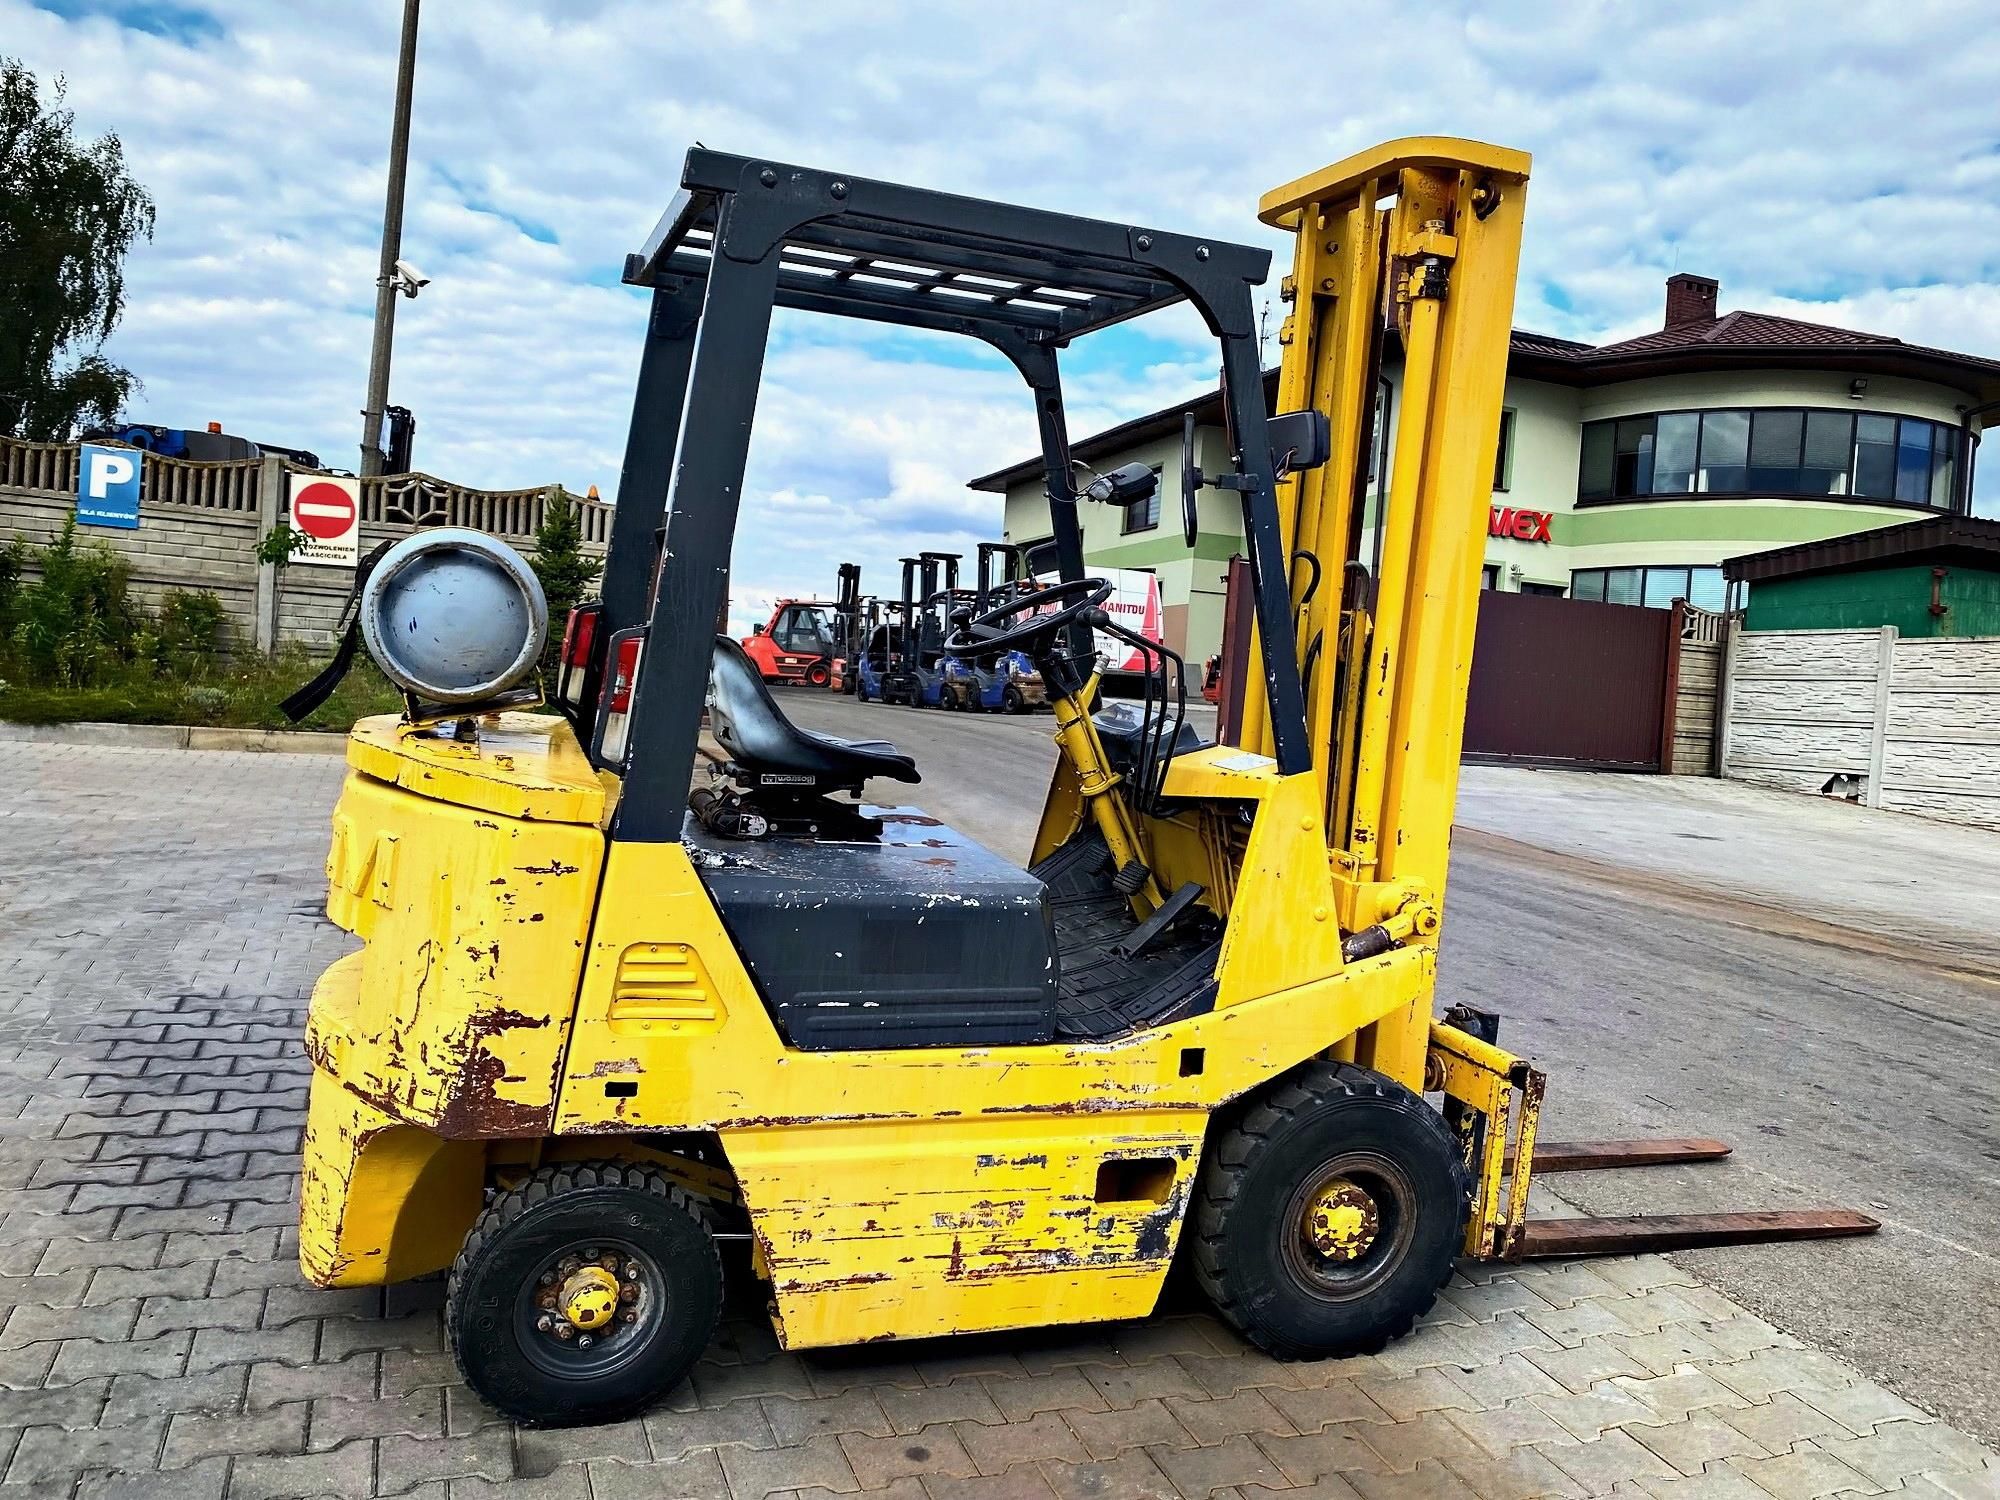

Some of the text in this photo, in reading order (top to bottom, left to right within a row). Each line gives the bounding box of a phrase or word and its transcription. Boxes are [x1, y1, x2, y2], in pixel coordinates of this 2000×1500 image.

[89, 453, 133, 499] P
[1488, 505, 1553, 542] MEX
[306, 544, 355, 552] OZWOLENIEM
[1098, 602, 1145, 614] MANITOU
